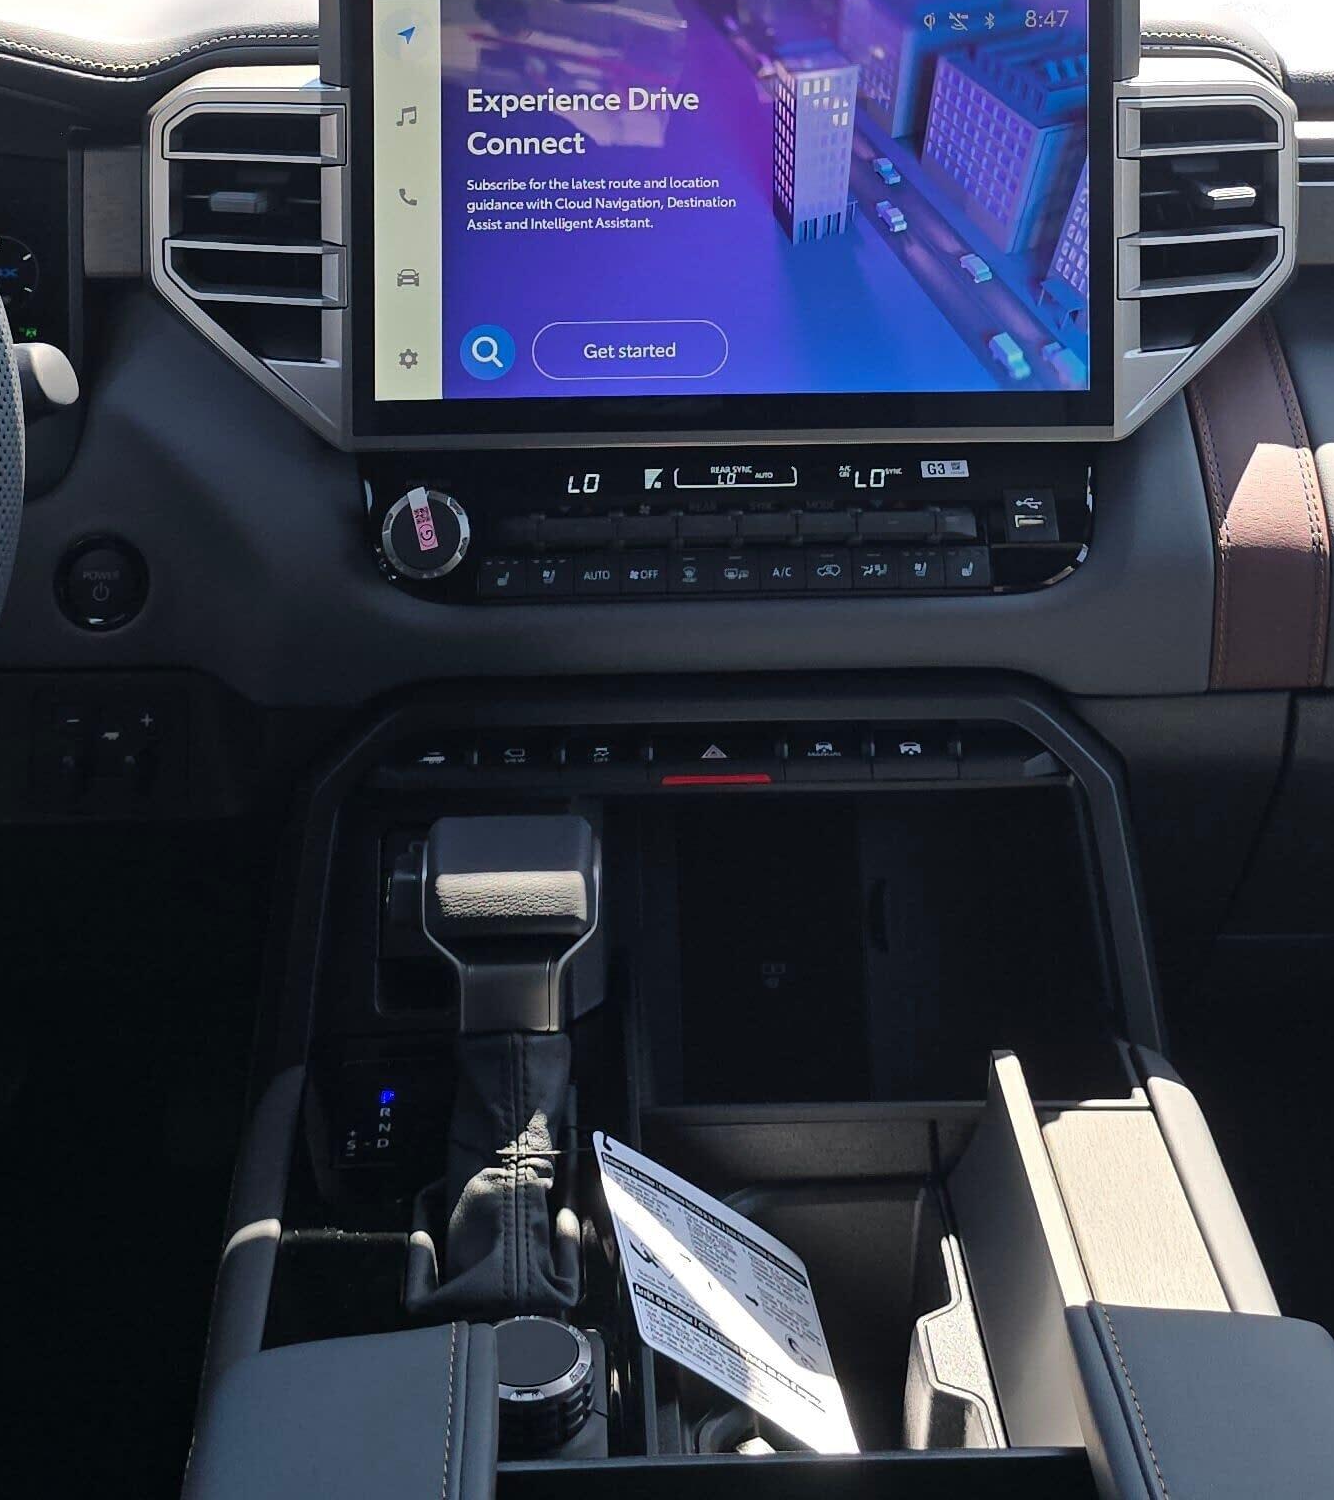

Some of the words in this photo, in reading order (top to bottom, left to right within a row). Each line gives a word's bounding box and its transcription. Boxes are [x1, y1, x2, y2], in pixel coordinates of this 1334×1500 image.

[1025, 9, 1069, 28] 8:47
[468, 88, 621, 118] Experience
[628, 87, 699, 111] Drive
[467, 132, 586, 155] Connect
[467, 177, 527, 191] Subscribe
[529, 178, 547, 190] for
[549, 178, 569, 190] the
[571, 177, 606, 189] latest
[608, 178, 641, 189] route
[644, 177, 667, 188] and
[669, 177, 719, 188] location
[467, 198, 524, 213] guidance
[526, 198, 553, 210] with
[555, 197, 593, 210] Cloud
[595, 197, 665, 212] Navigation,
[667, 196, 736, 209] Destination
[467, 218, 503, 231] Assist
[505, 218, 528, 230] and
[531, 218, 593, 231] Intelligent
[595, 216, 654, 230] Assistant.
[584, 344, 615, 358] Get
[618, 342, 676, 358] started
[711, 466, 731, 474] REAR
[927, 463, 946, 476] G3
[755, 472, 774, 480] AUTO
[854, 469, 885, 488] LO
[568, 474, 601, 494] LO
[82, 570, 121, 581] POWER
[583, 570, 611, 581] AUTO
[640, 569, 659, 580] OFF
[772, 566, 792, 578] A/C
[379, 1107, 392, 1117] R
[378, 1122, 392, 1132] N
[346, 1140, 357, 1151] S
[376, 1138, 390, 1149] D
